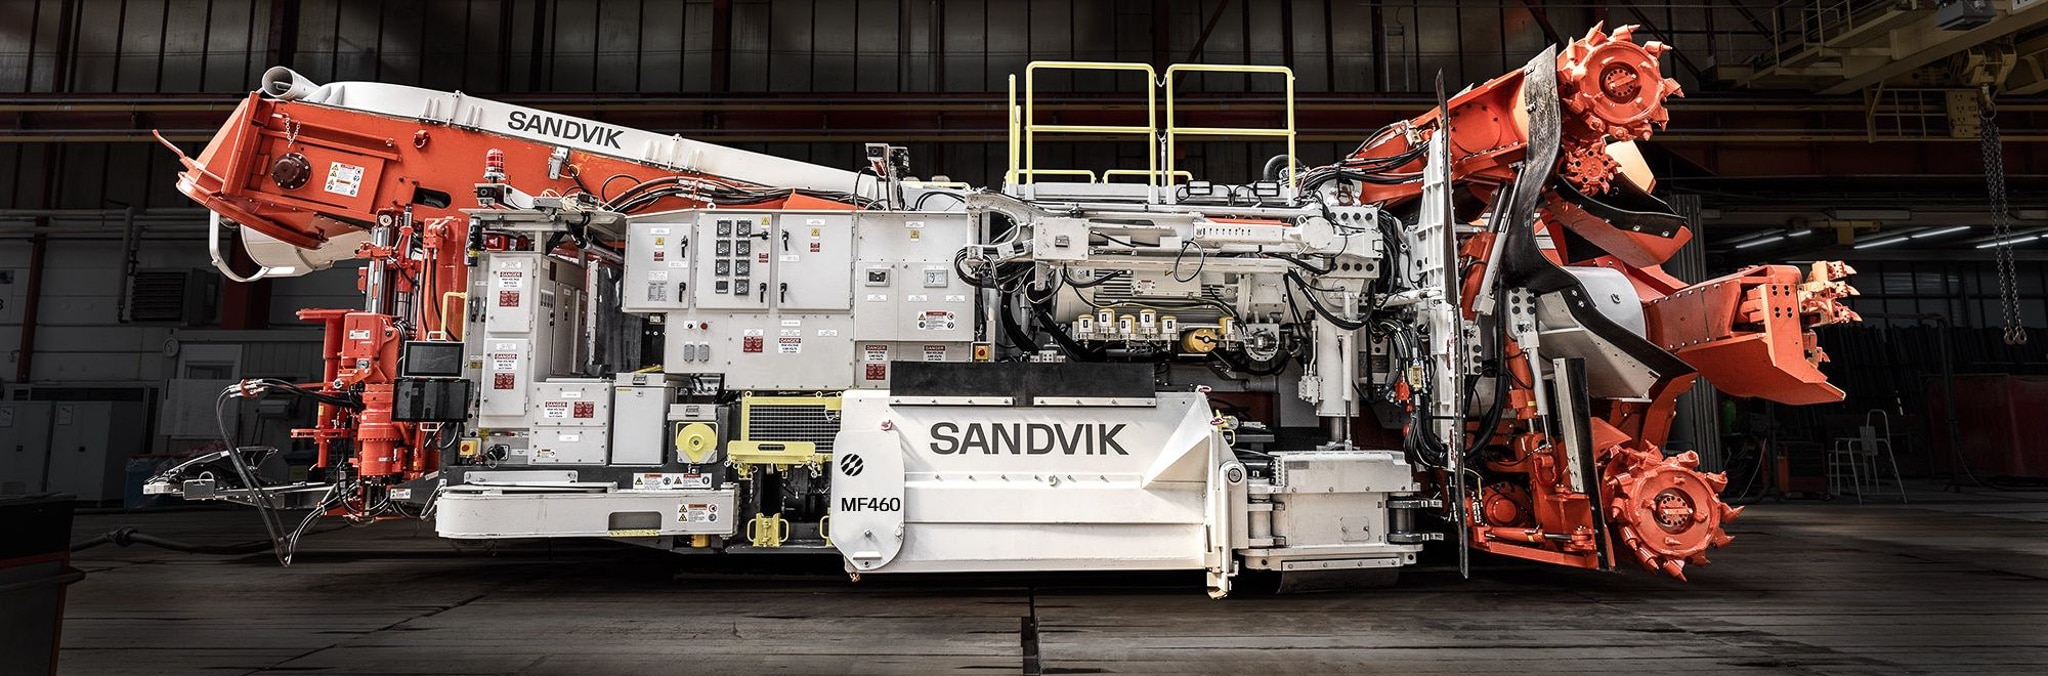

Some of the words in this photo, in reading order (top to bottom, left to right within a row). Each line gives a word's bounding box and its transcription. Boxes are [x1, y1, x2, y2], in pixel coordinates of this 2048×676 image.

[507, 110, 624, 149] SANDVIK
[930, 422, 1129, 455] SANDVIK
[841, 497, 901, 511] MF460
